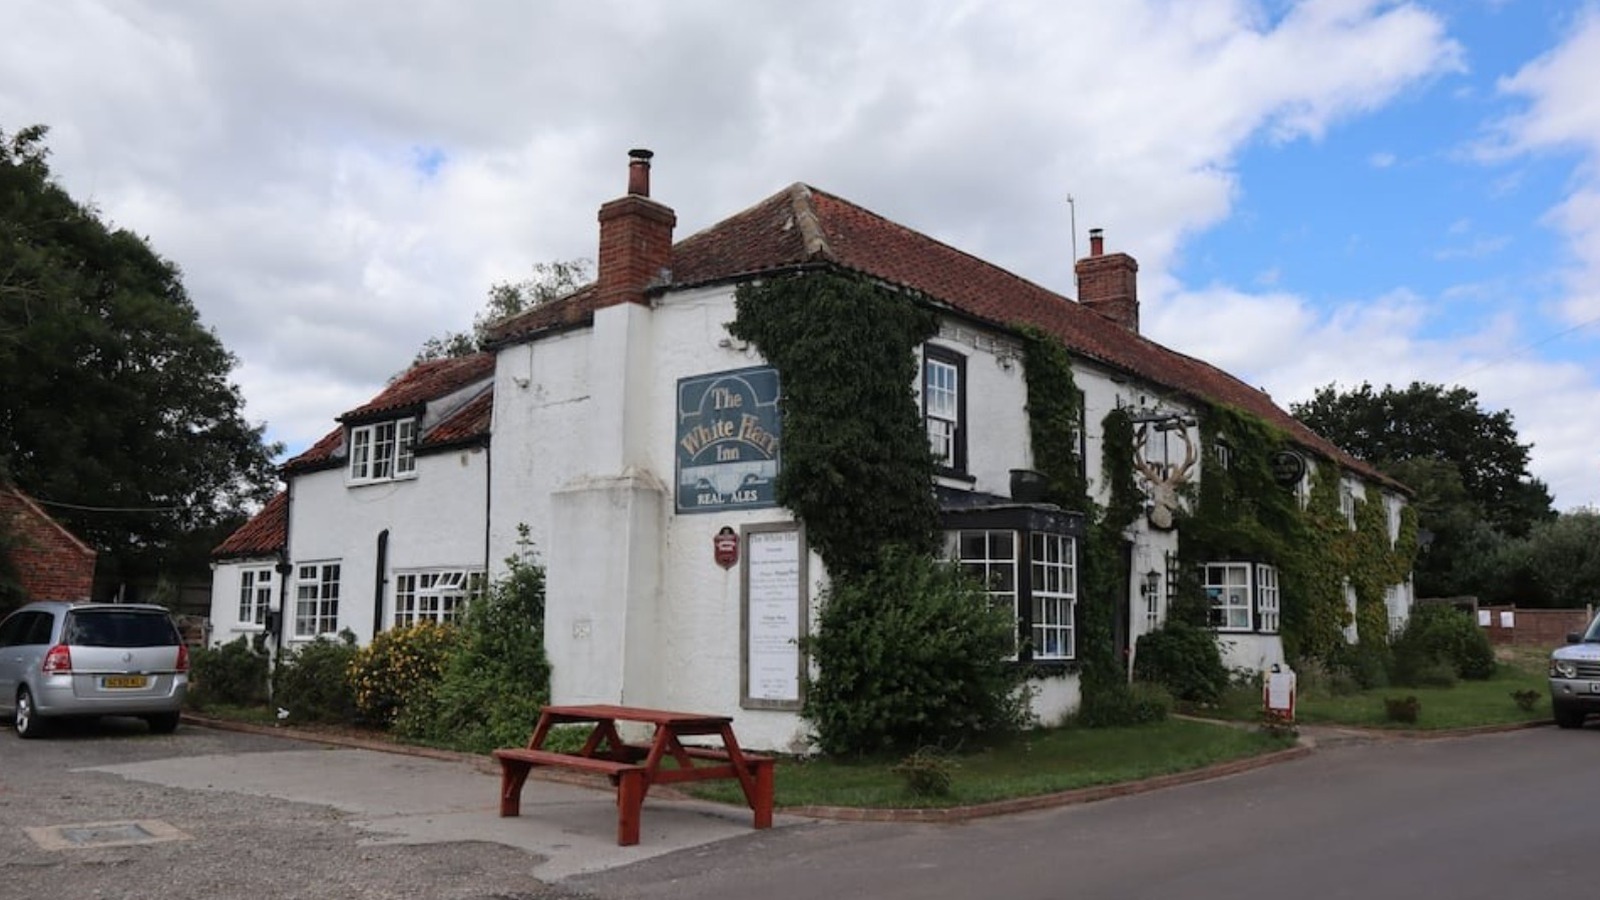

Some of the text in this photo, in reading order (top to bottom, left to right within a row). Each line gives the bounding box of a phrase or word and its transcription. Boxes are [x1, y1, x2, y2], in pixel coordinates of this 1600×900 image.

[711, 387, 743, 410] The
[680, 413, 780, 456] White Hart
[716, 444, 740, 461] Inn
[697, 489, 758, 505] REAL ALES
